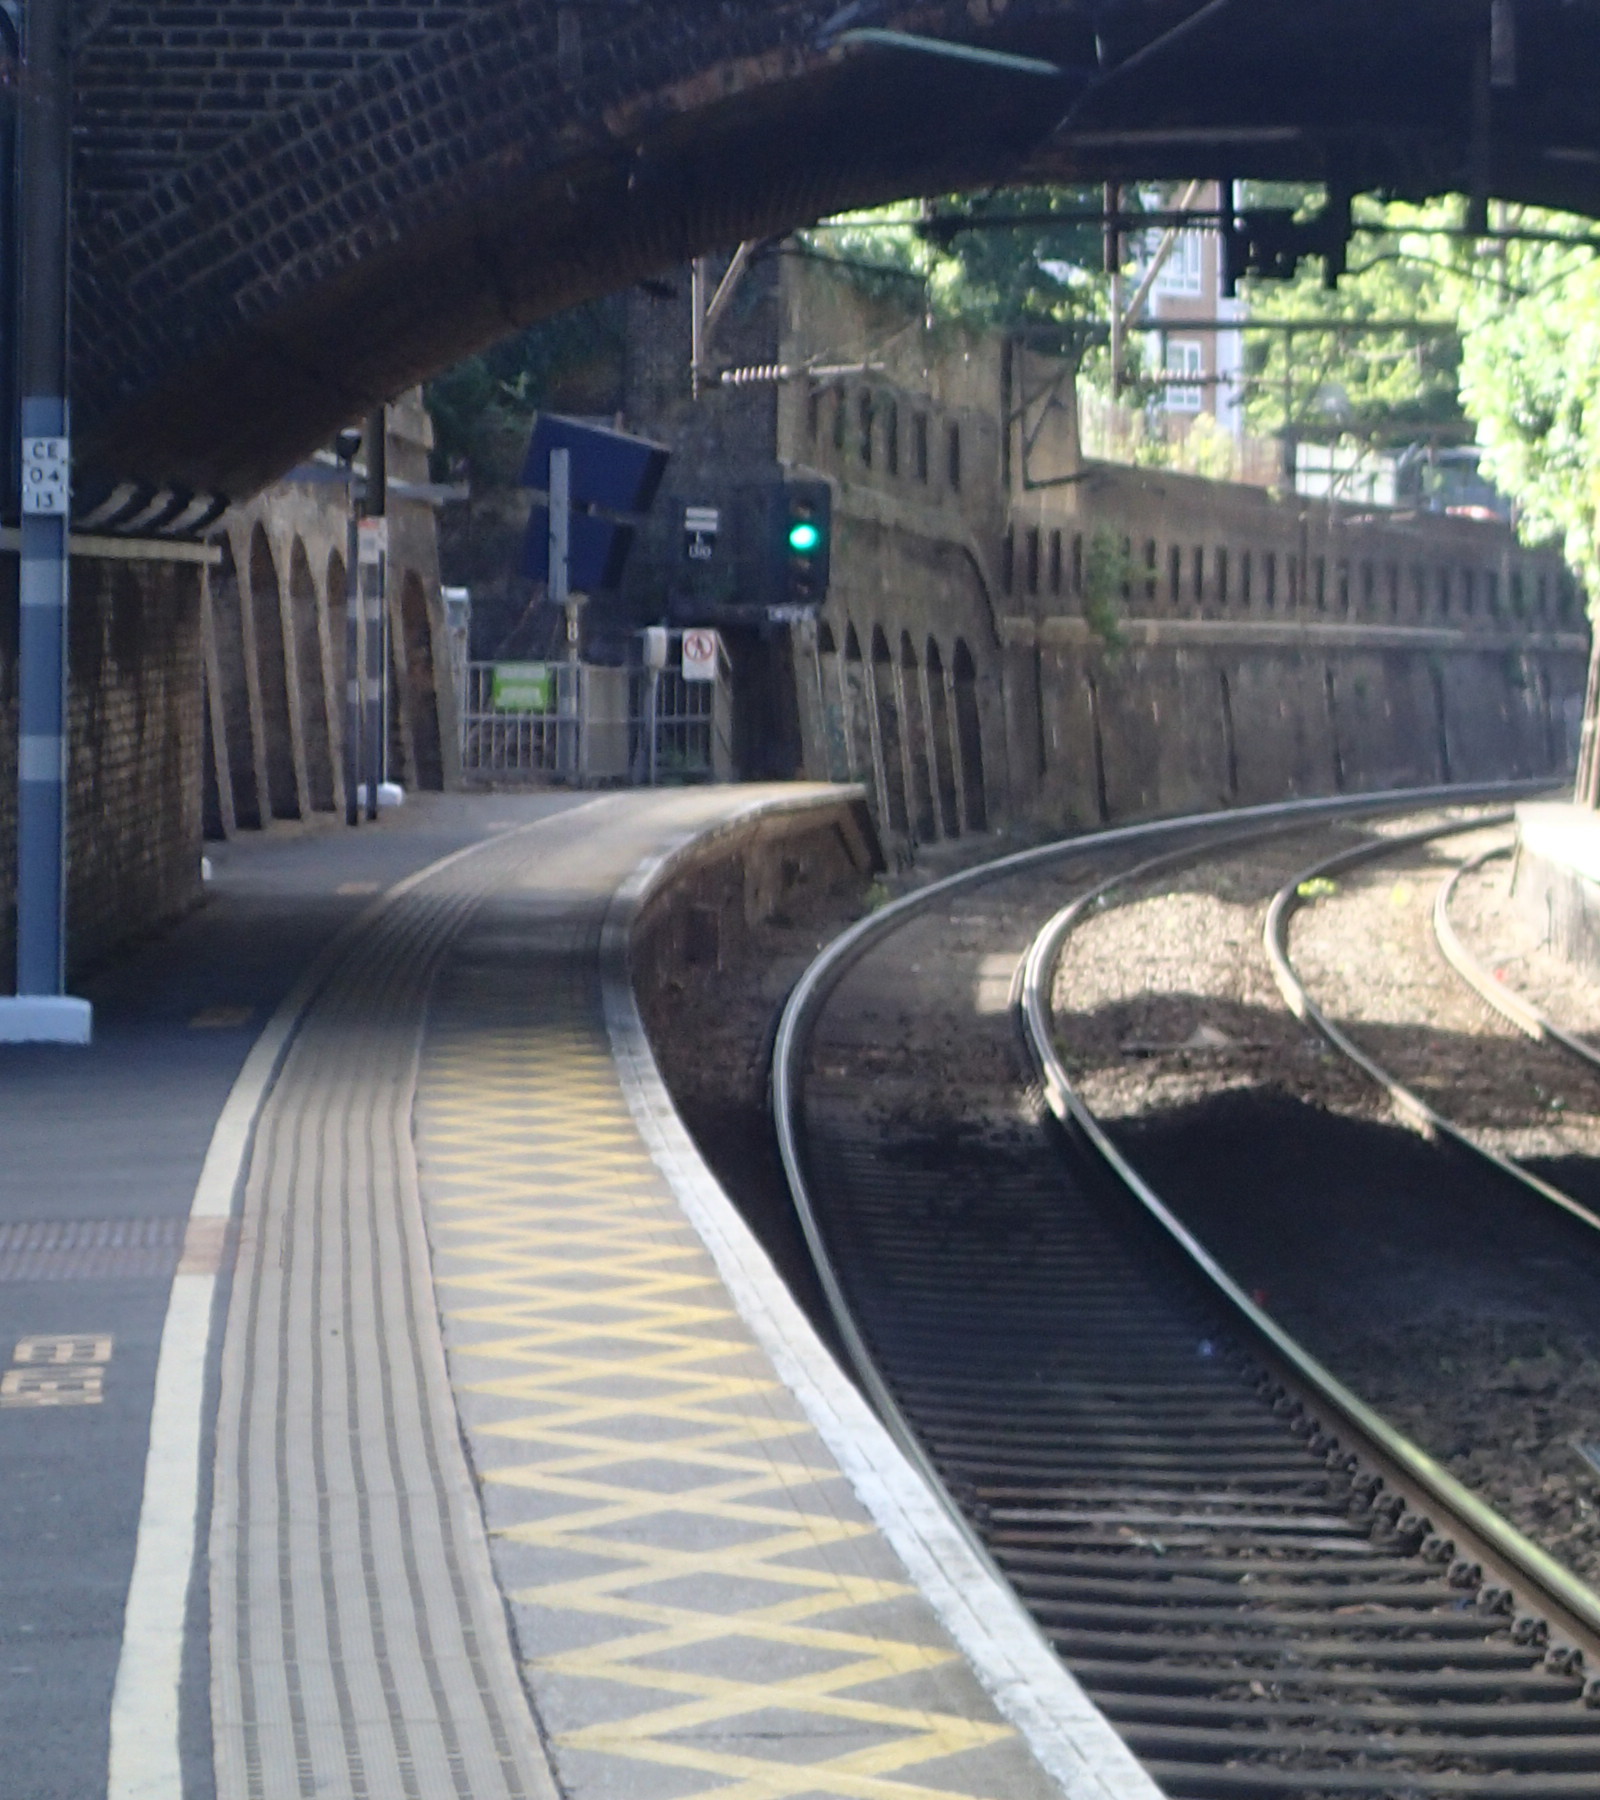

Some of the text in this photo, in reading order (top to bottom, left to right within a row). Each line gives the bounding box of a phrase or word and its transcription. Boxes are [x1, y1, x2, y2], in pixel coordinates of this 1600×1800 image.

[33, 441, 59, 459] CE
[30, 466, 60, 484] 04
[36, 491, 54, 509] 13
